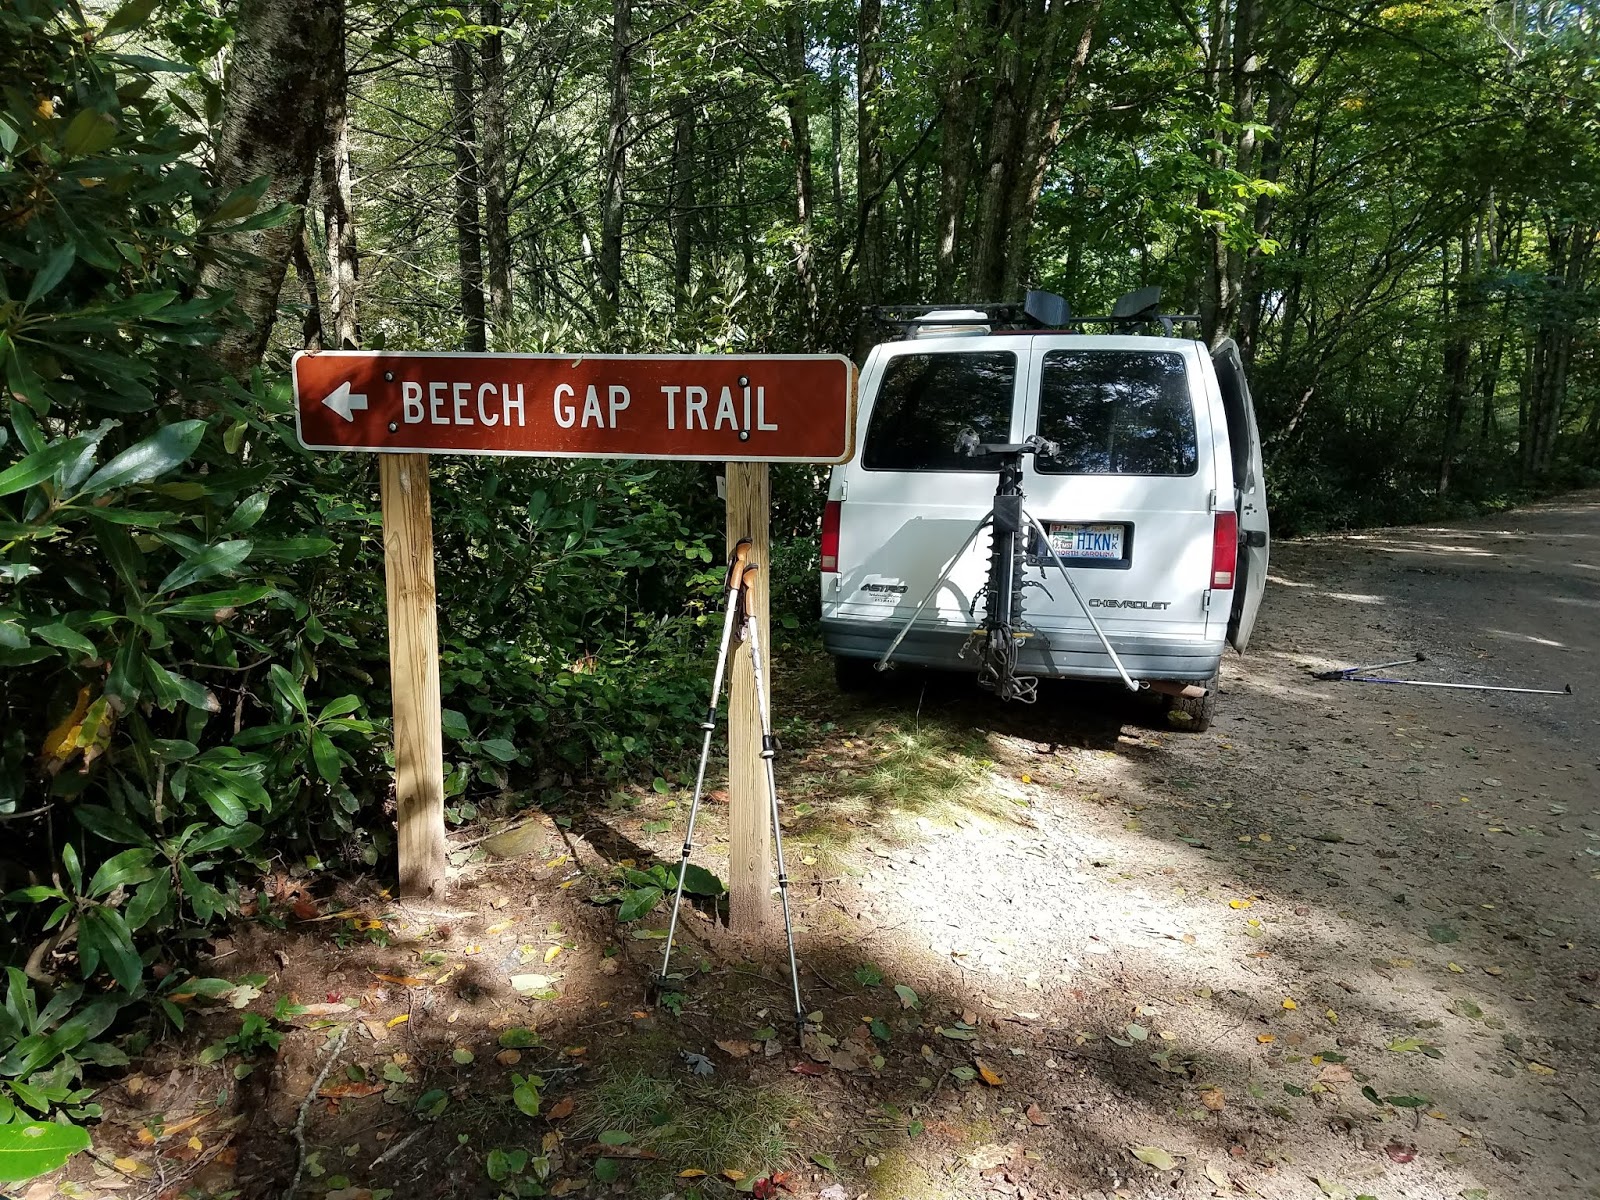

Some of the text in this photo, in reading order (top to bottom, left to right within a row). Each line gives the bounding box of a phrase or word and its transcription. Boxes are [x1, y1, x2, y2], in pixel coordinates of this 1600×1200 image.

[402, 381, 778, 431] BEECH GAP TRAIL
[1077, 532, 1111, 551] HIKN
[860, 583, 908, 593] ASTRO
[1089, 599, 1171, 610] CHEVROLET
